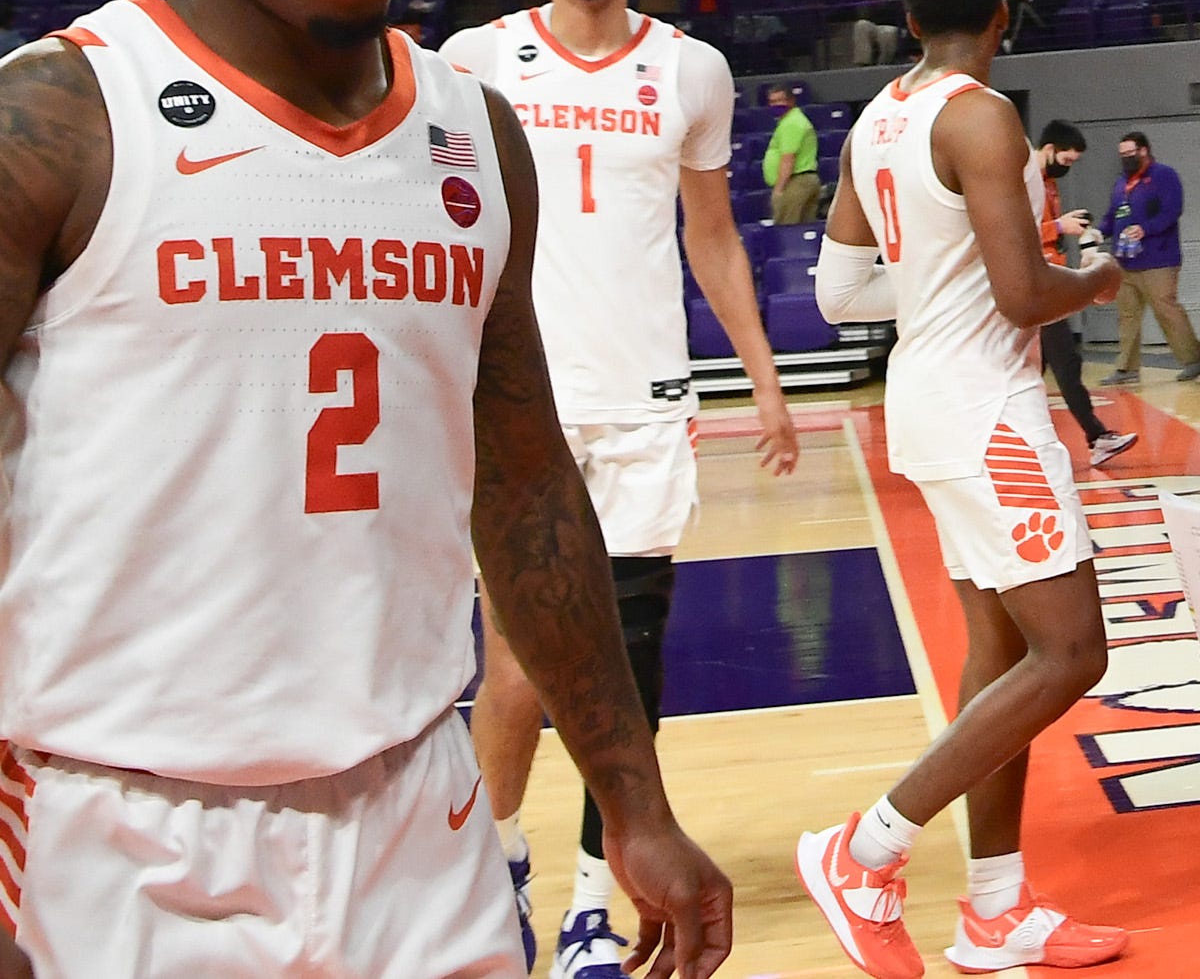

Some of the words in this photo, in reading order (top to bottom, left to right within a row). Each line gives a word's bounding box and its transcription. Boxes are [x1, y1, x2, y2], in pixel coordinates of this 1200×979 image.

[160, 94, 210, 108] UNITY
[514, 103, 661, 136] CLEMSON
[577, 144, 596, 213] 1
[876, 168, 903, 262] 0
[156, 237, 485, 308] CLEMSON
[304, 332, 380, 514] 2
